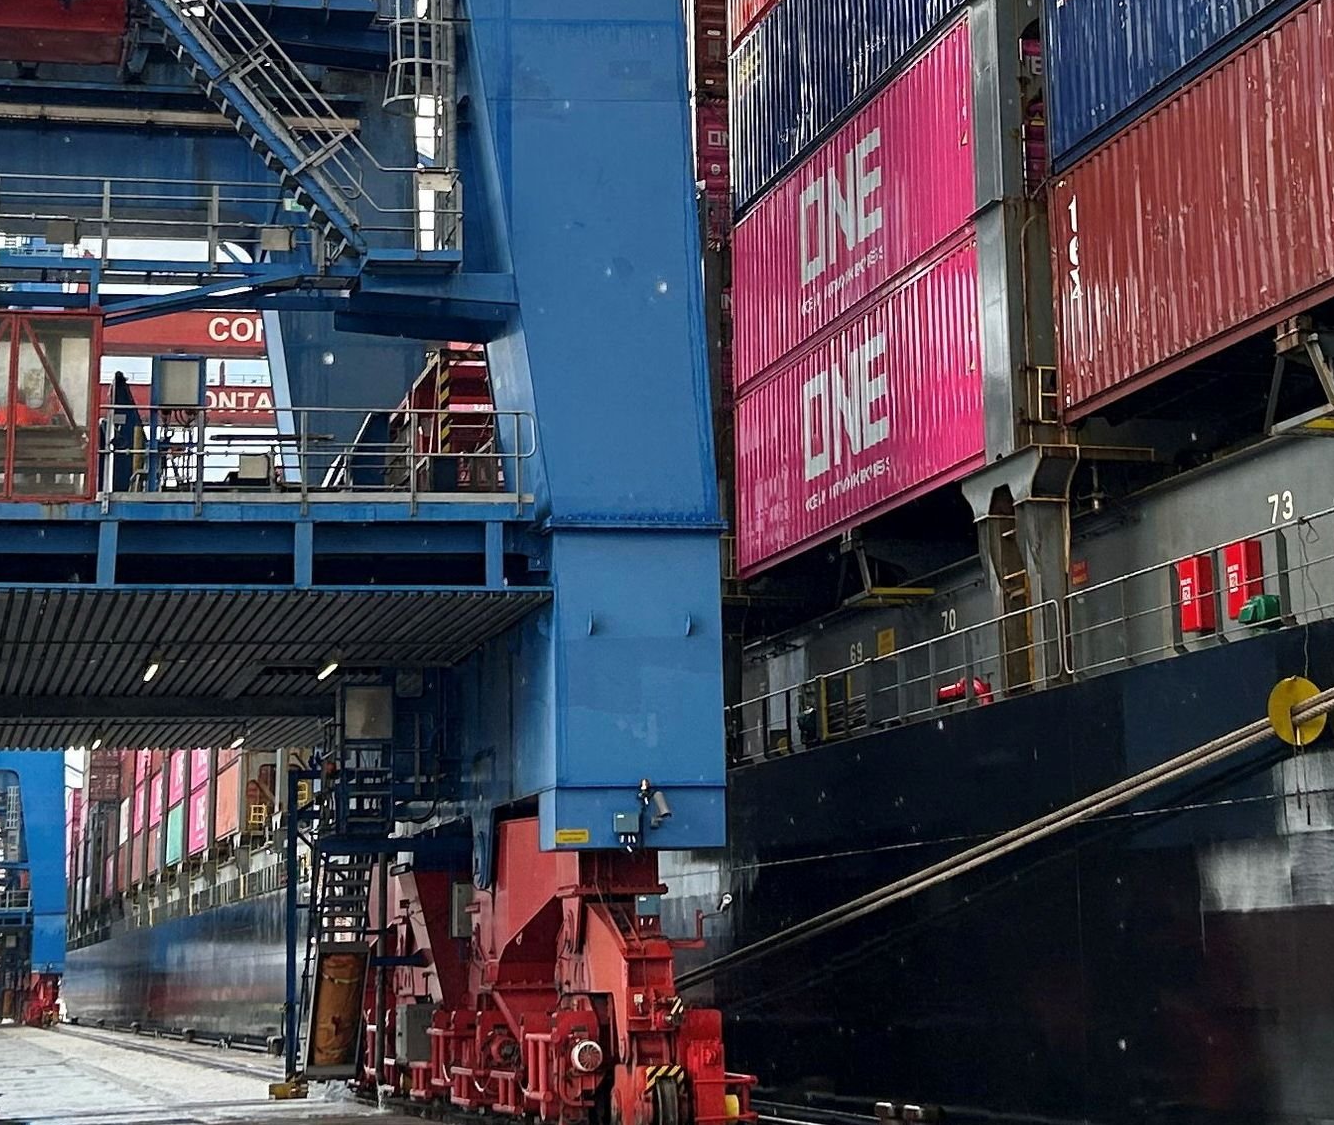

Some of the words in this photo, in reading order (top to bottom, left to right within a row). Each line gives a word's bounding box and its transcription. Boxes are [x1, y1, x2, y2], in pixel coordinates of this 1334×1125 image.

[799, 127, 884, 289] ONE
[804, 331, 890, 482] ONE
[1268, 490, 1294, 525] 73
[941, 608, 957, 632] 70
[849, 642, 863, 664] 69
